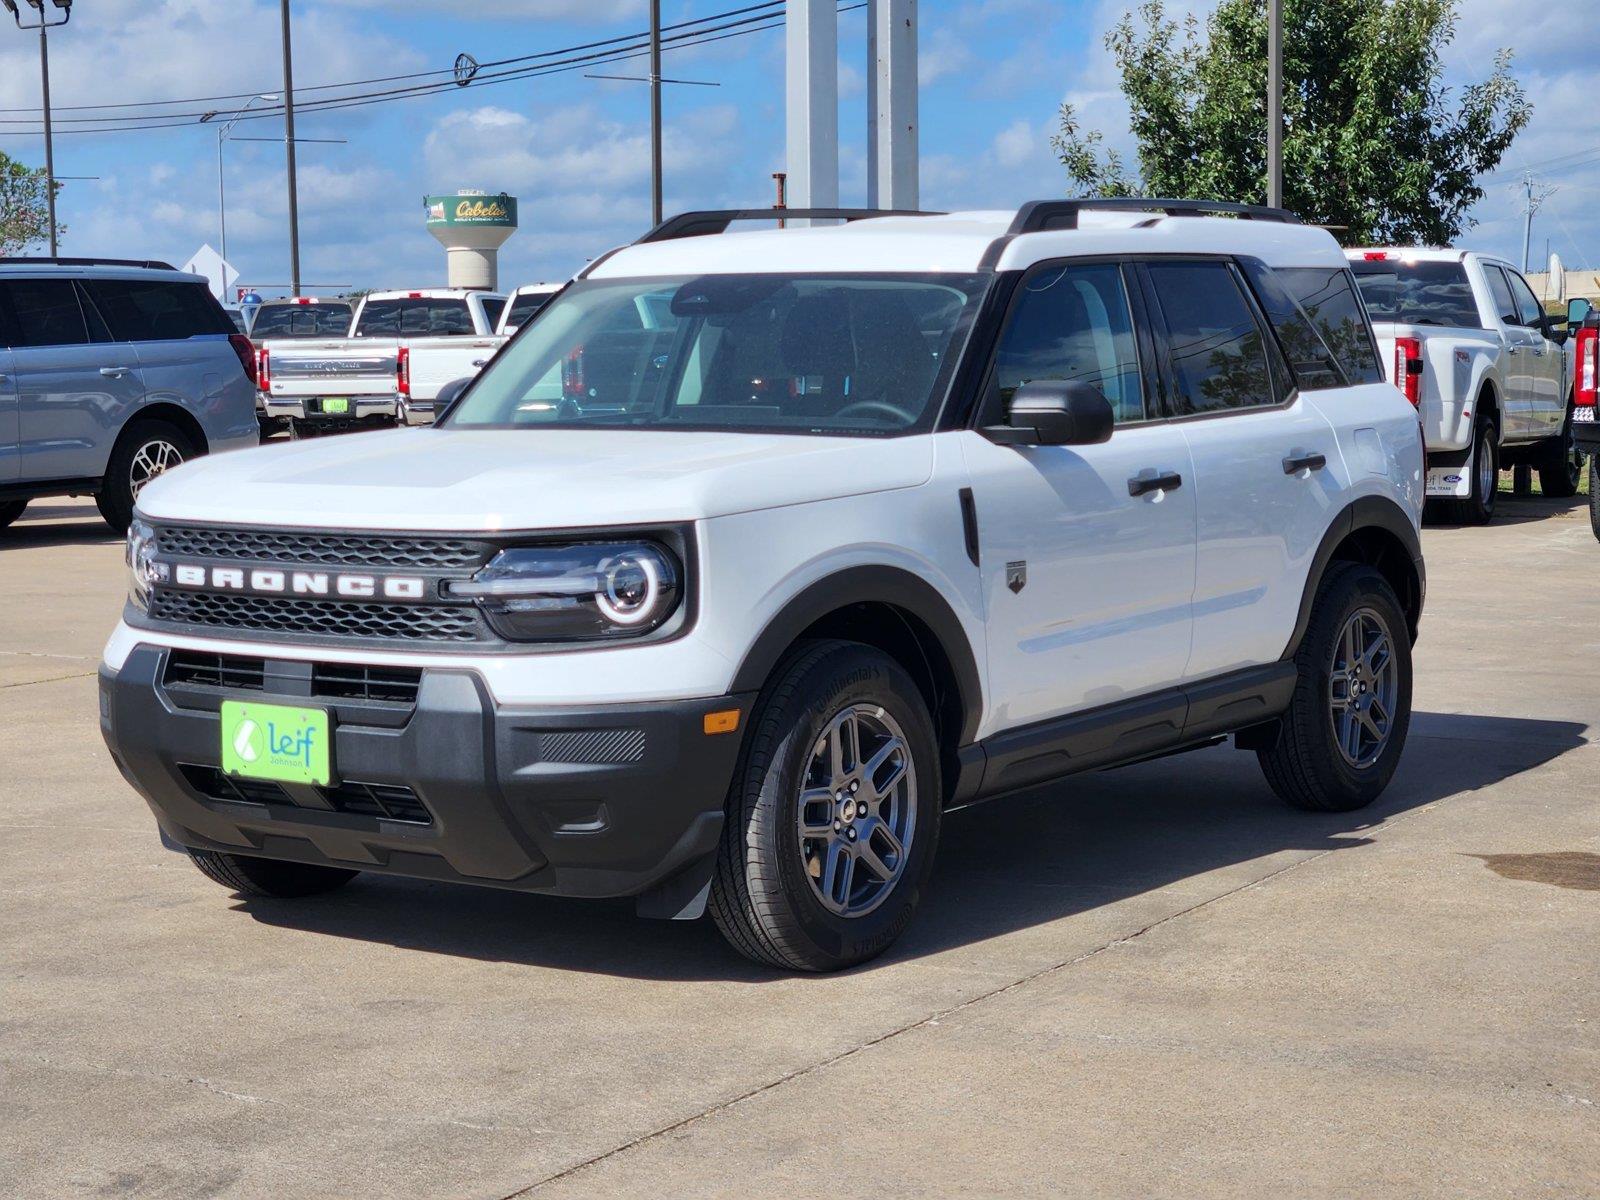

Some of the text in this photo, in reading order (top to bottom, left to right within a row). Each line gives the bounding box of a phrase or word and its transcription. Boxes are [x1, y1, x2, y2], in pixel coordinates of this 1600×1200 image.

[176, 564, 424, 598] BRONCO
[268, 722, 316, 768] leif
[270, 757, 303, 767] Johnson
